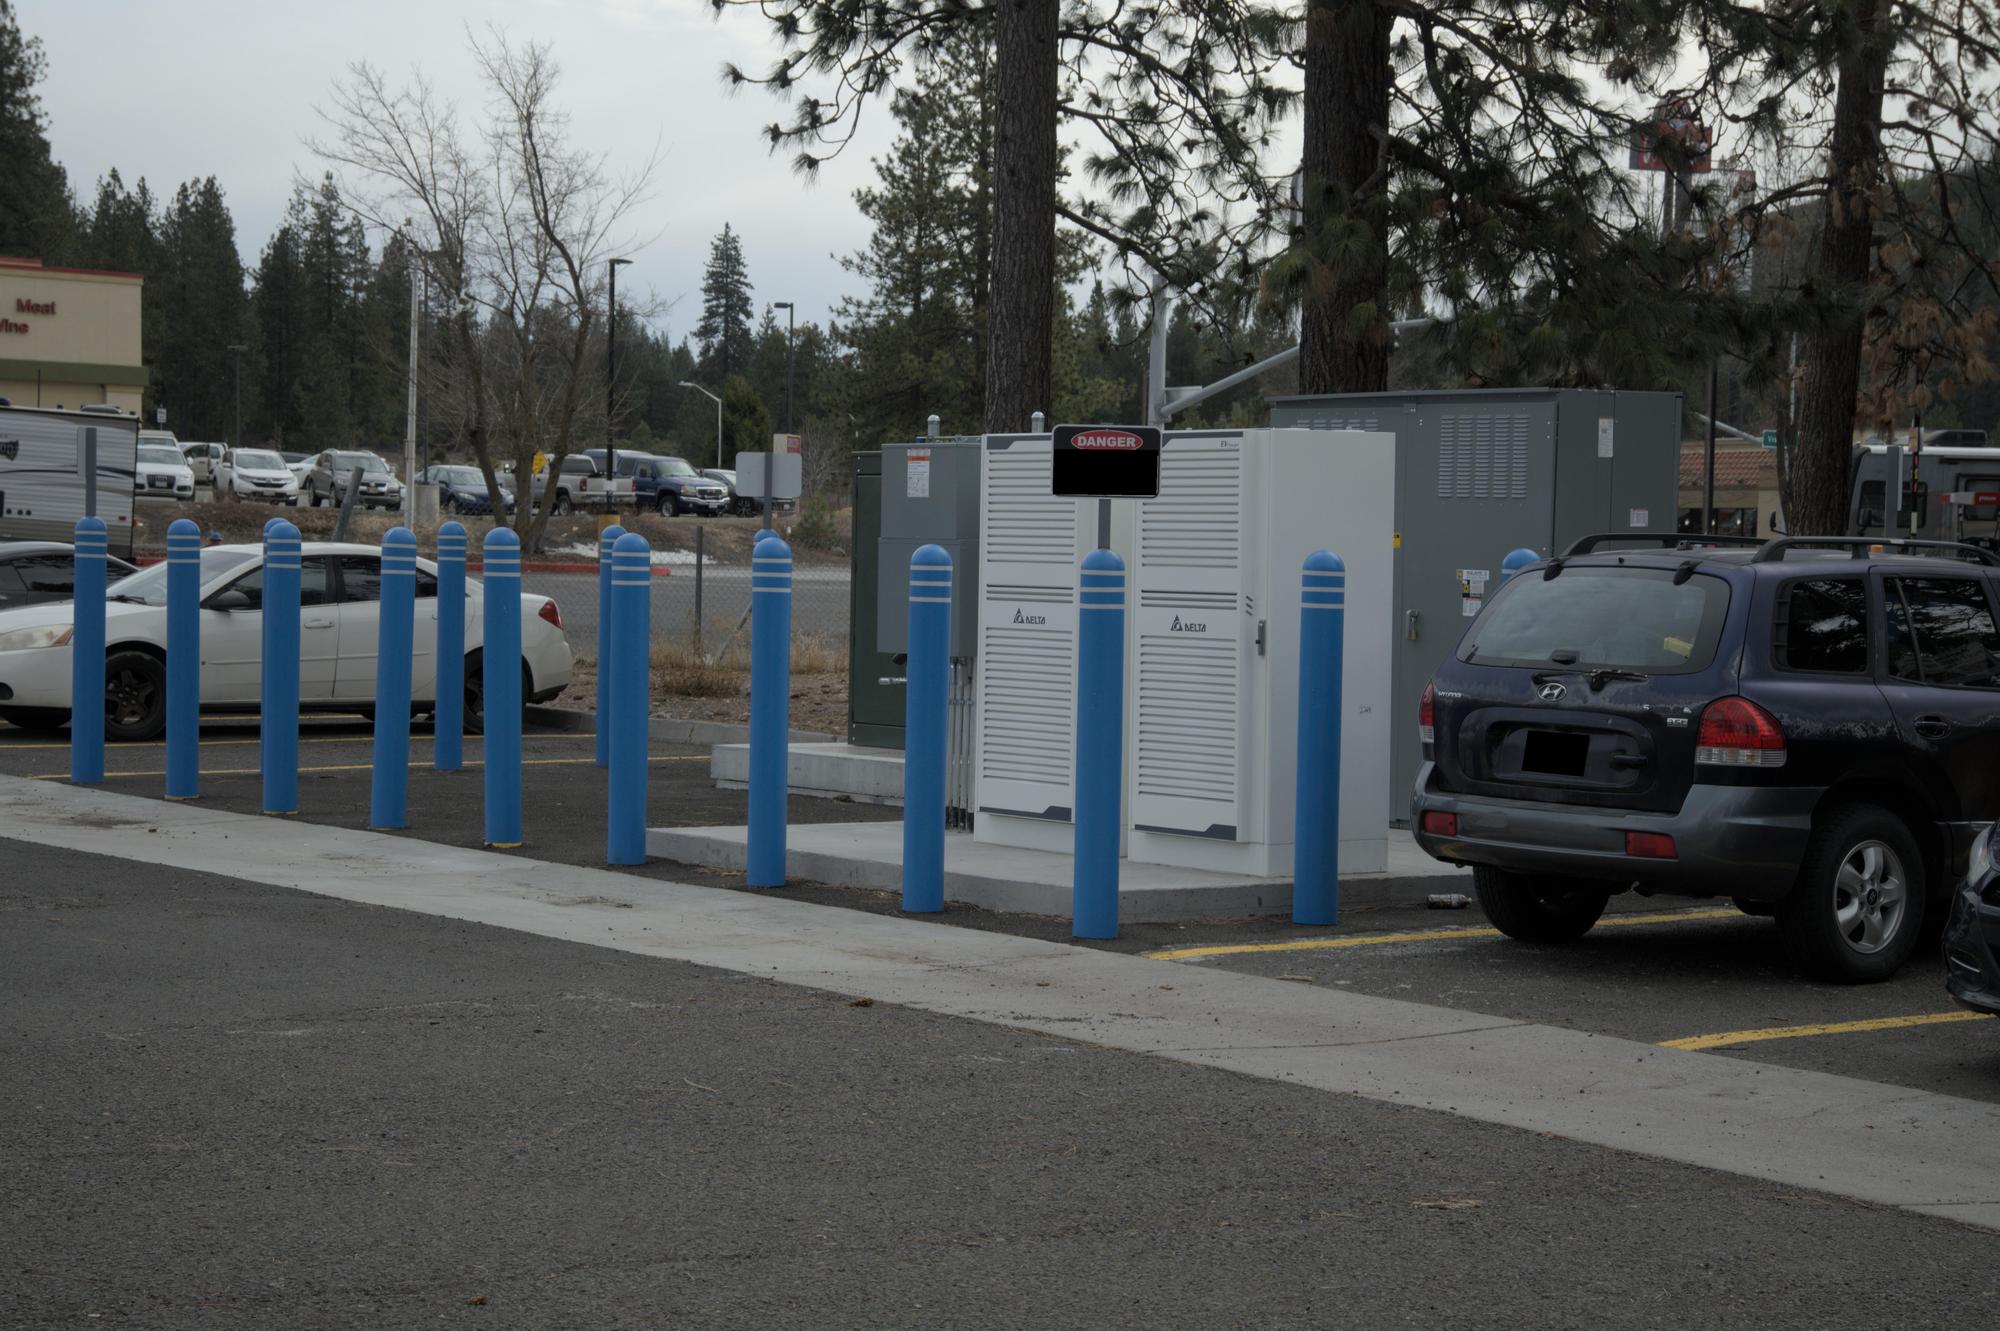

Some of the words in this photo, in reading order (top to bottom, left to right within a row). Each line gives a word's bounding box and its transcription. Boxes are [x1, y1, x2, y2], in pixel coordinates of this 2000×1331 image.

[16, 298, 56, 315] Meat
[1077, 436, 1136, 447] DANGER
[1025, 615, 1046, 625] DELTA
[1184, 622, 1207, 633] DELTA
